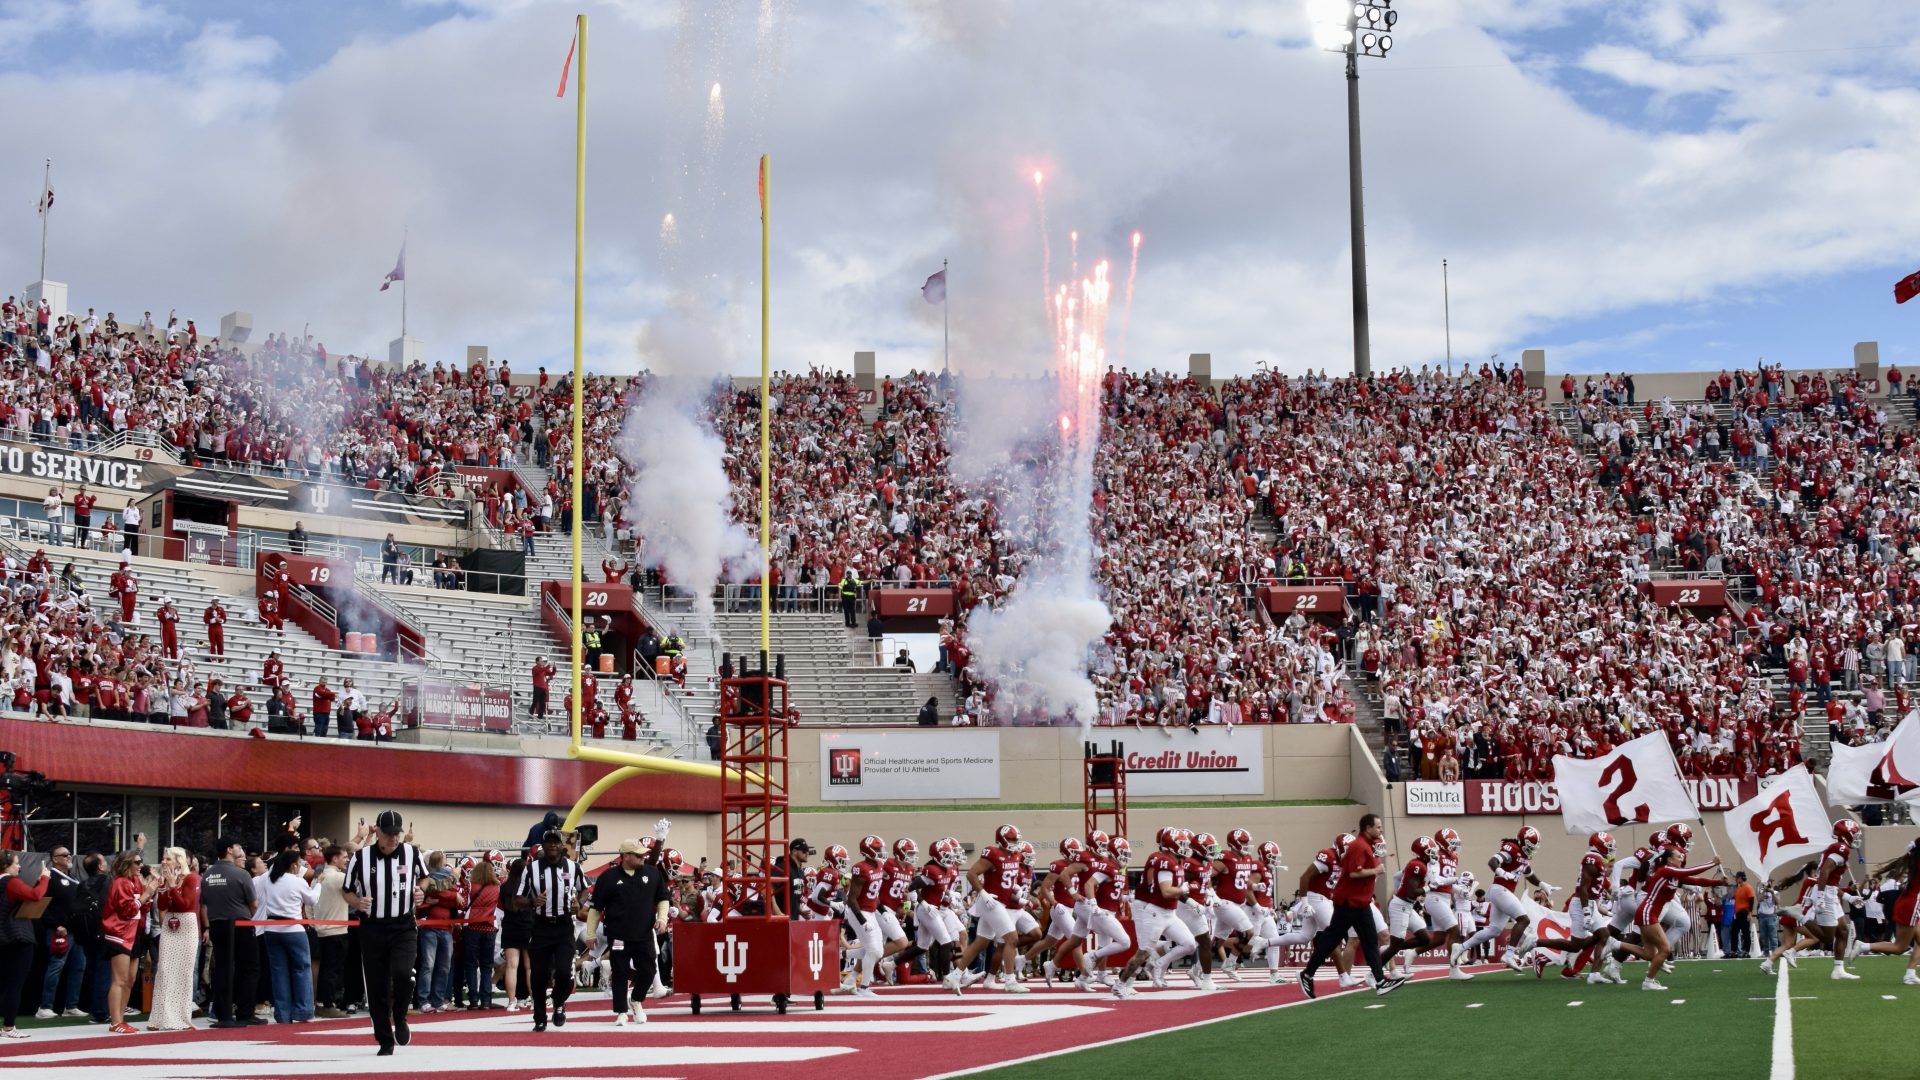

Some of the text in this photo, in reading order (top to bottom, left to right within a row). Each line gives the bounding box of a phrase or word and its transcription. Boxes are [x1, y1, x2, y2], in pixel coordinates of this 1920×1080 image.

[514, 386, 531, 397] 20
[857, 391, 873, 402] 21
[134, 448, 153, 460] 19
[31, 450, 143, 490] SERVICE
[466, 474, 489, 483] EAST
[310, 566, 330, 583] 19
[586, 591, 608, 607] 20
[1678, 588, 1701, 603] 23
[906, 597, 928, 612] 21
[1295, 594, 1318, 609] 22
[425, 693, 510, 705] INDIANA UNIVERSITY
[425, 700, 510, 719] MARCHING HUNDRED
[940, 757, 962, 766] Sports
[1127, 750, 1238, 769] Credit Union
[1409, 787, 1461, 803] Simtra
[1481, 782, 1562, 812] HOOS
[981, 848, 991, 858] 97
[1635, 848, 1646, 859] 30
[1839, 845, 1846, 853] 2
[1317, 852, 1328, 862] 52
[371, 866, 377, 874] S
[1160, 860, 1169, 869] 14
[1413, 865, 1420, 875] 3
[823, 872, 833, 881] 28
[400, 882, 406, 891] H
